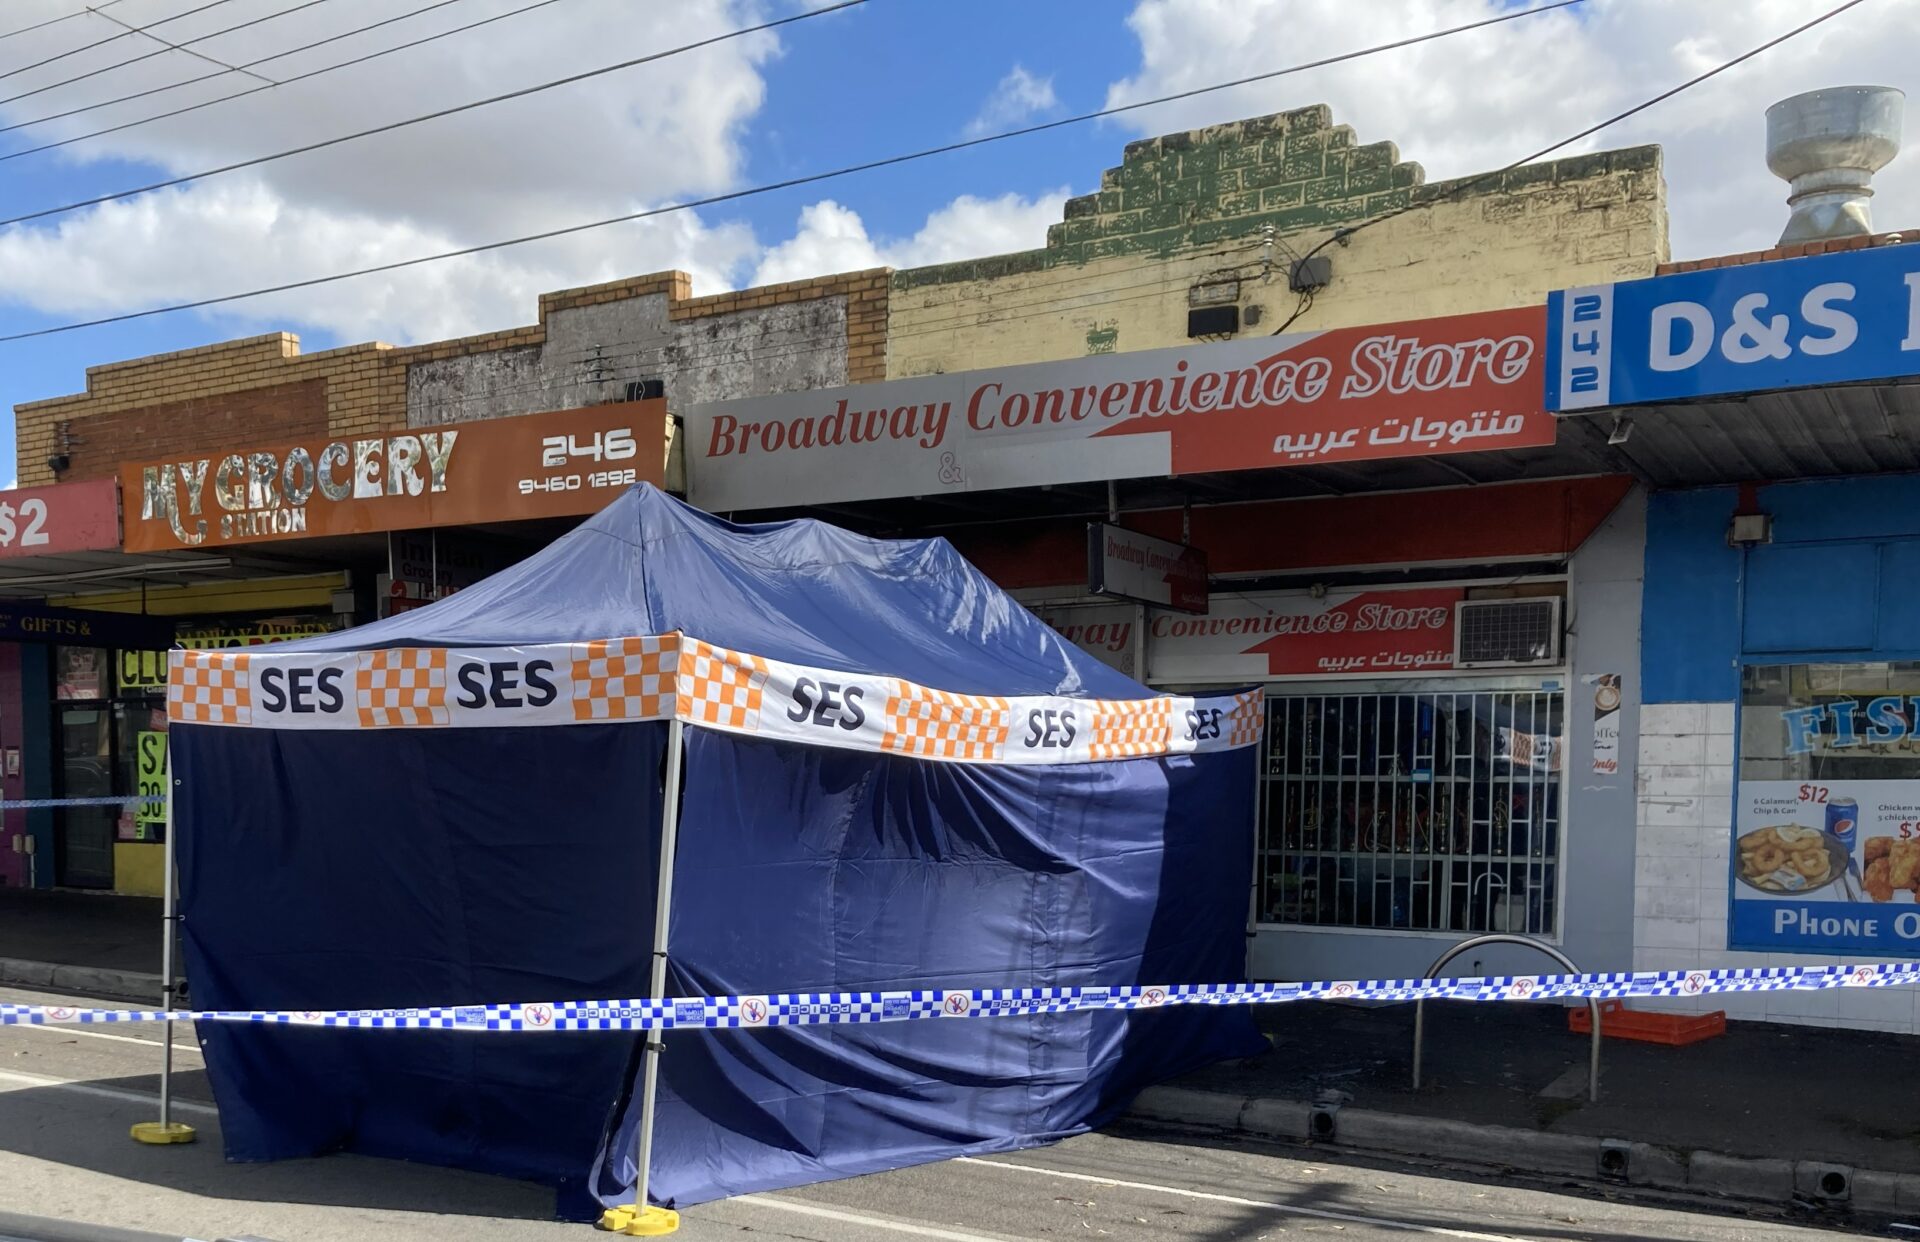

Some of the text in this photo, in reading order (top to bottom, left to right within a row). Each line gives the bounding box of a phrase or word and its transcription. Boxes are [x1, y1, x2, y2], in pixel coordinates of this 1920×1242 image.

[1571, 294, 1602, 393] 242
[1649, 282, 1859, 372] D&S
[705, 335, 1535, 458] Broadway Convenience Store
[542, 428, 637, 467] 246
[1273, 410, 1524, 459] منتوجات عربيه
[518, 468, 636, 495] 9460 1292
[938, 451, 963, 484] &
[141, 430, 459, 545] MY GROCERY
[0, 498, 50, 547] $2
[219, 506, 307, 540] STATION
[20, 616, 78, 635] GIFTS
[80, 620, 92, 636] &
[1047, 603, 1448, 651] way Convenience Store
[260, 666, 344, 713] SES
[457, 659, 558, 707] SES
[786, 675, 865, 731] SES
[1184, 703, 1222, 739] SES
[1025, 707, 1076, 749] SES
[1753, 807, 1771, 815] Chip
[1798, 784, 1829, 804] $12
[1884, 813, 1918, 821] chicken
[578, 1009, 642, 1019] POLICE
[790, 1004, 850, 1014] POLICE
[992, 998, 1051, 1008] POLICE
